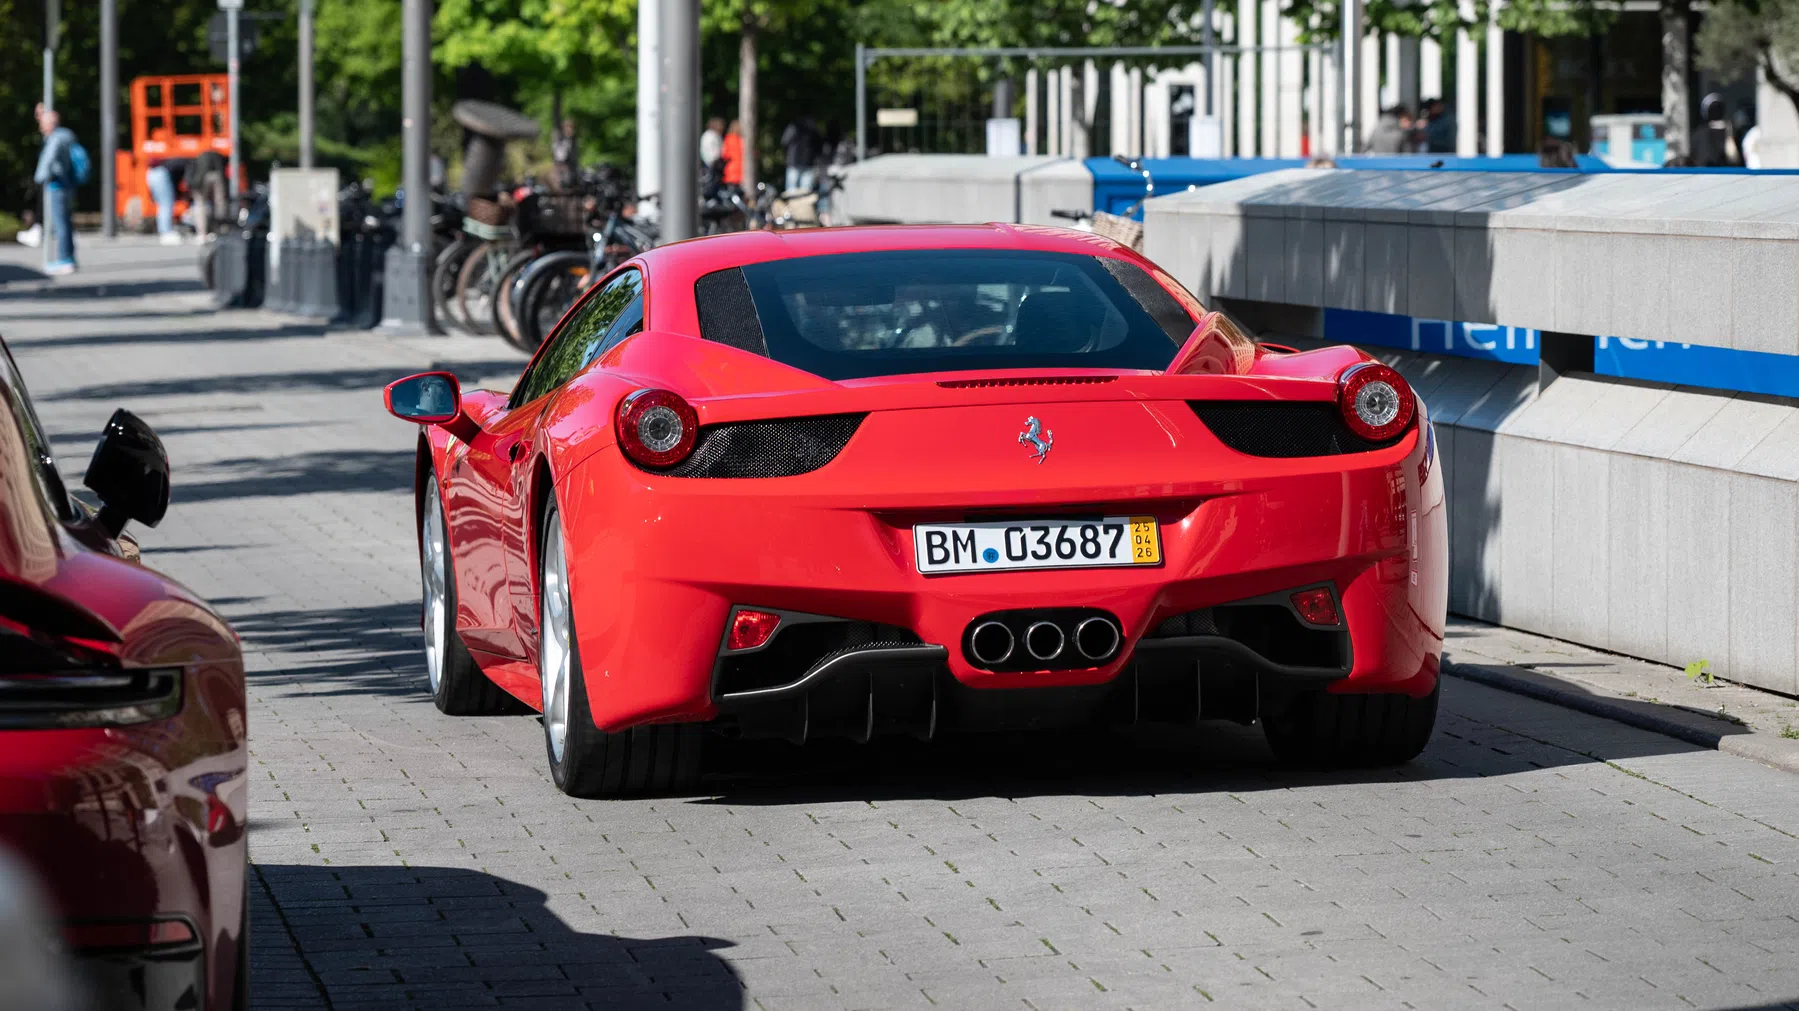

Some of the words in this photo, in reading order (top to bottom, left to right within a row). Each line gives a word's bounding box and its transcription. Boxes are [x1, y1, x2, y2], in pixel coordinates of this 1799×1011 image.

[1134, 521, 1150, 532] 25
[925, 529, 977, 565] BM
[1004, 524, 1124, 562] 03687
[1135, 535, 1151, 545] 04
[1137, 547, 1152, 558] 26
